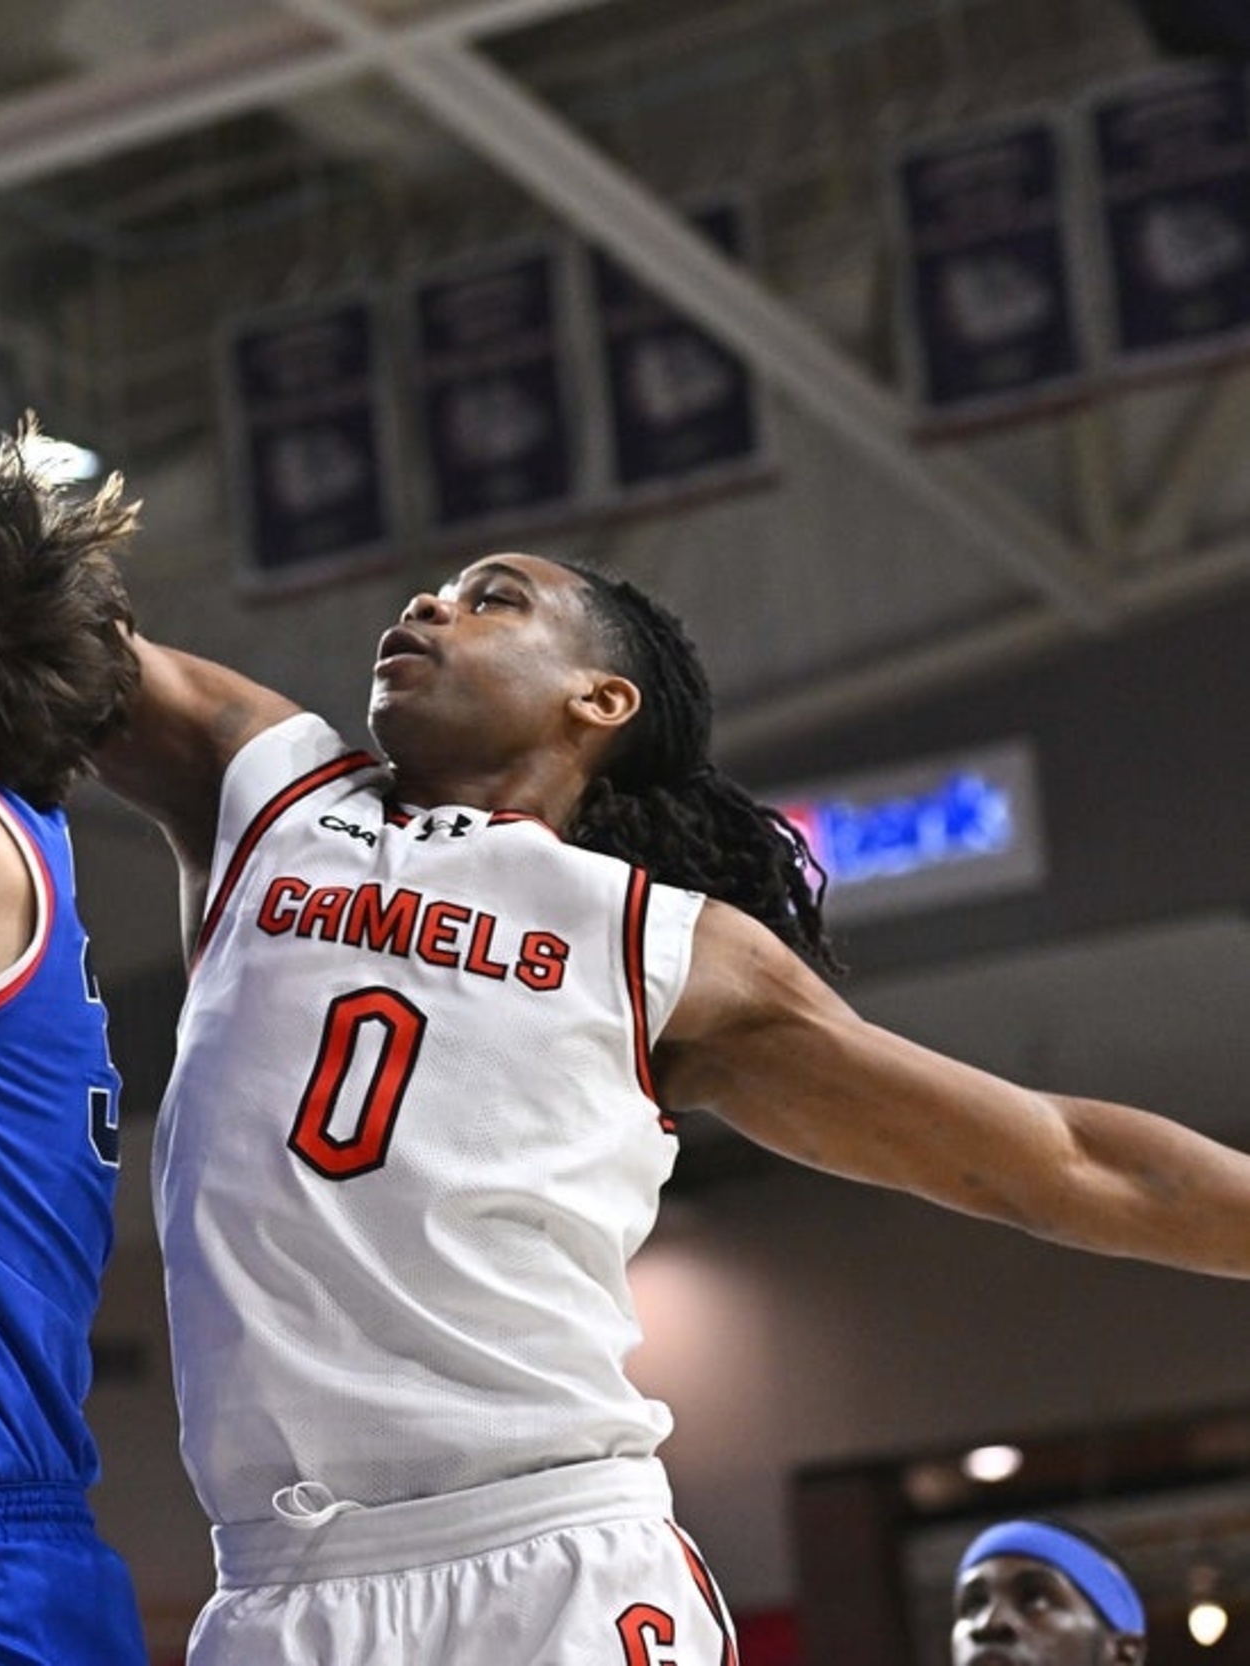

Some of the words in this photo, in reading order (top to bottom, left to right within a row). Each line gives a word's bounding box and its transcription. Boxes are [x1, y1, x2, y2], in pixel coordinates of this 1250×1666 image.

[319, 815, 378, 848] CAA
[256, 876, 570, 992] CAMELS
[287, 985, 428, 1181] 0
